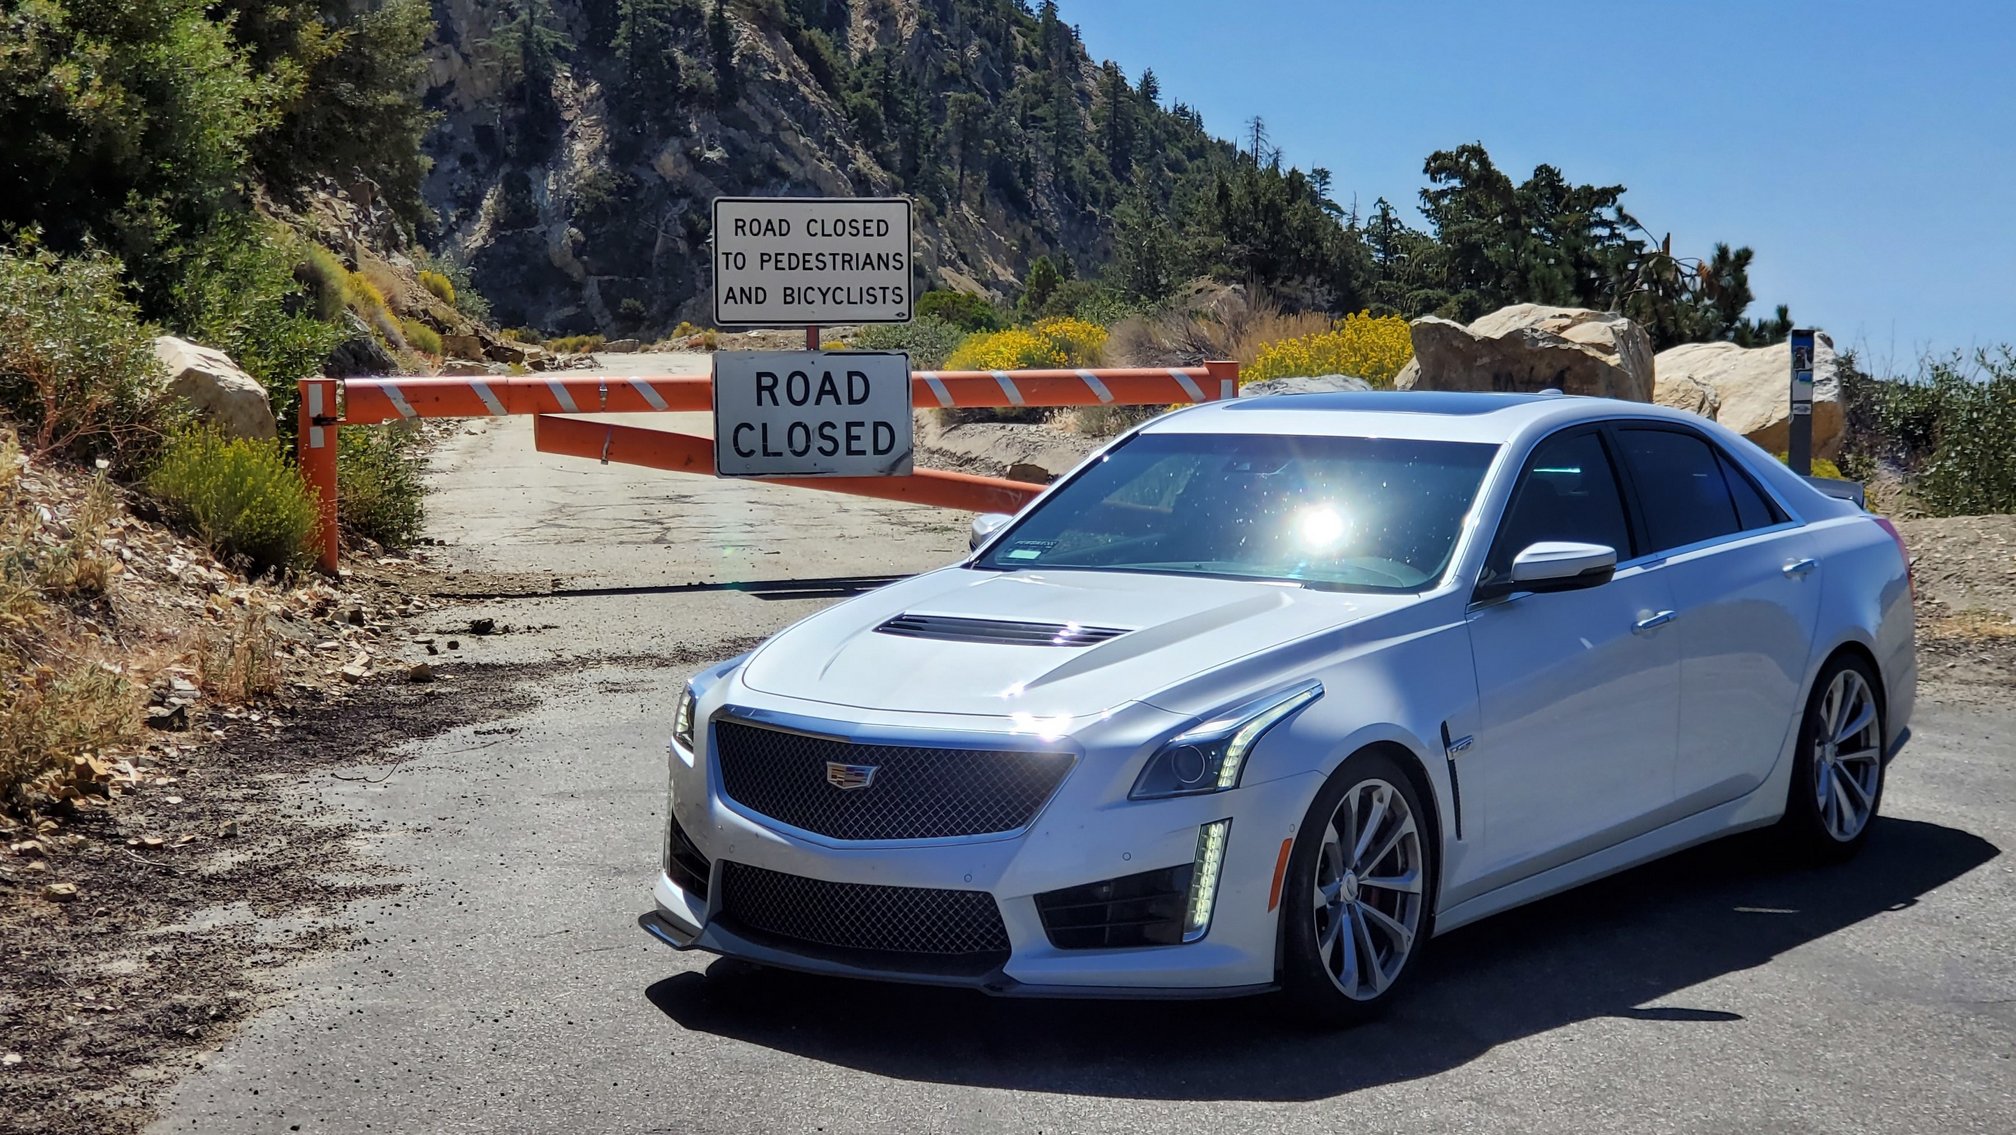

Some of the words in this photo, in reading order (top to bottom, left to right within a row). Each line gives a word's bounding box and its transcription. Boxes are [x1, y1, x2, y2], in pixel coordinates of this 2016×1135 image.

[734, 218, 791, 237] ROAD
[806, 218, 889, 237] CLOSED
[721, 251, 746, 271] TO
[759, 252, 904, 271] PEDESTRIANS
[723, 286, 767, 305] AND
[783, 286, 904, 305] BICYCLISTS
[755, 371, 870, 406] ROAD
[732, 421, 896, 458] CLOSED
